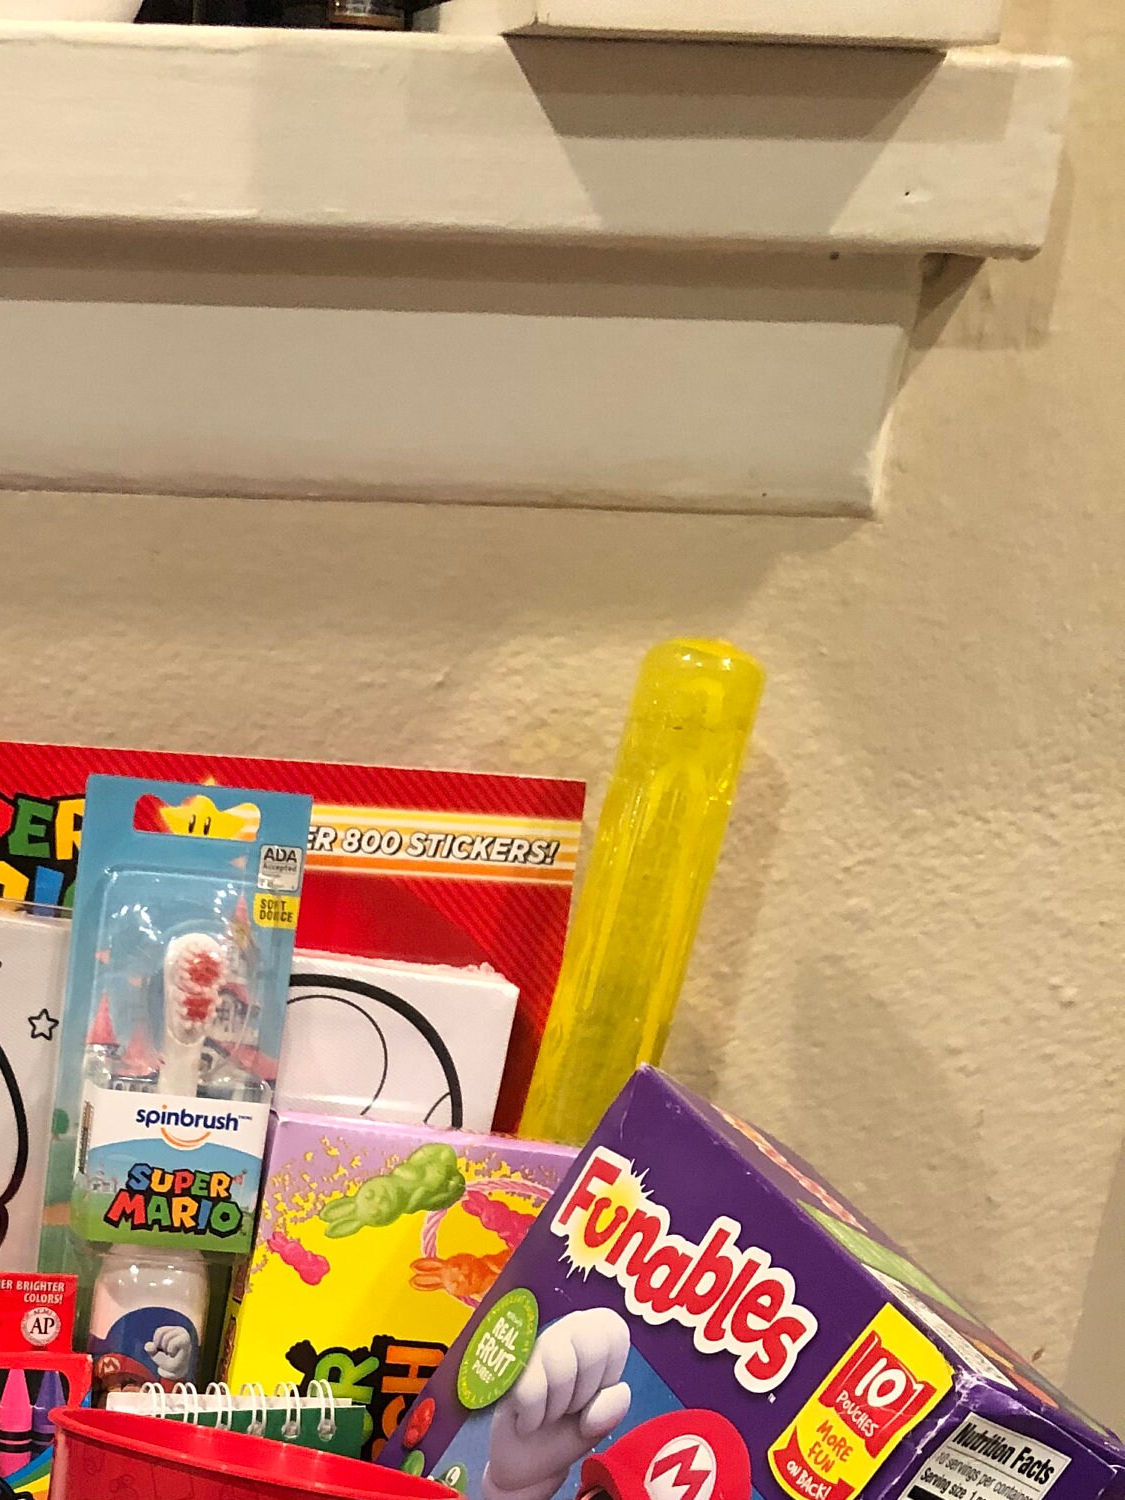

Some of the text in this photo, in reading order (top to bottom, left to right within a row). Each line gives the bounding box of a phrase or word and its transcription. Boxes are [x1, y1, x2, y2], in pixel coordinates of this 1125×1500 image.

[263, 847, 297, 863] ADA
[306, 826, 561, 865] ER 800 STICKERS!
[135, 1104, 239, 1132] spinbrush
[126, 1163, 234, 1199] SUPER
[103, 1189, 244, 1238] MARIO
[558, 1156, 808, 1381] Funables
[16, 1280, 66, 1293] BRIGHTER
[23, 1292, 64, 1305] COLORS!
[30, 1317, 55, 1335] AP
[491, 1316, 520, 1351] REAL
[475, 1331, 517, 1378] FRUIT
[854, 1357, 907, 1408] 10
[836, 1389, 880, 1438] POUCHES
[808, 1440, 836, 1473] FUN
[816, 1419, 854, 1463] MORE
[953, 1423, 1055, 1486] Nutrition Facts
[786, 1460, 800, 1477] ON
[920, 1466, 950, 1495] Serving
[948, 1483, 966, 1499] size
[945, 1458, 980, 1481] servings
[976, 1473, 995, 1486] per
